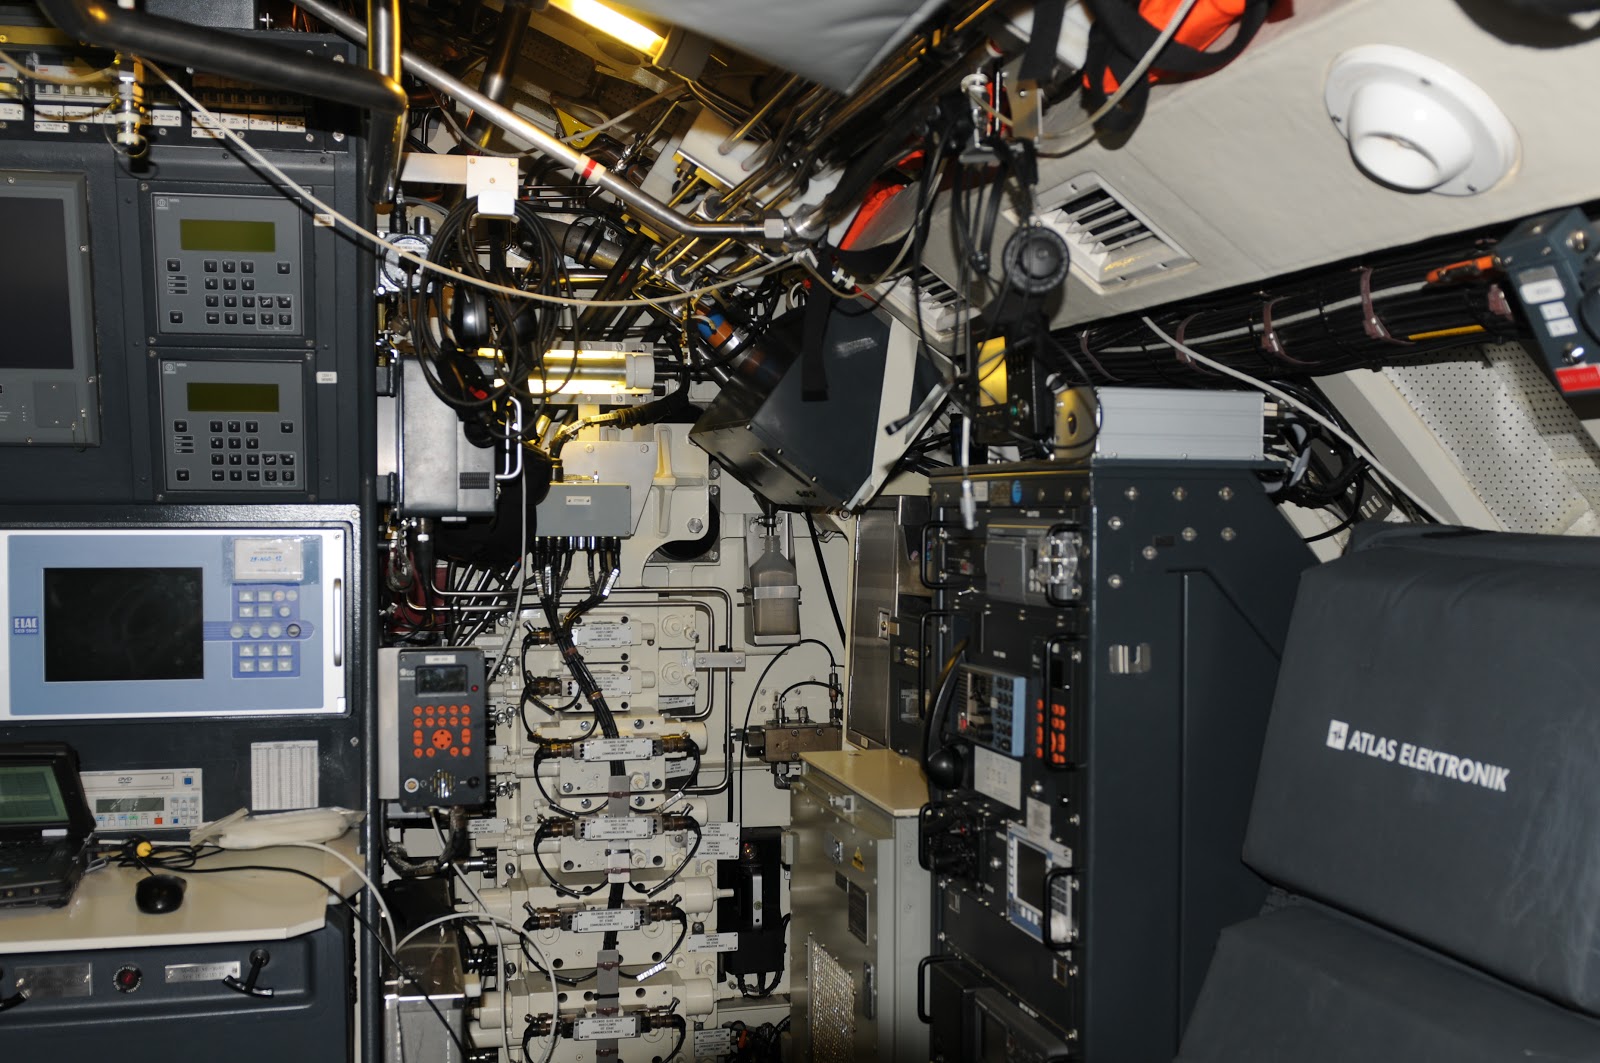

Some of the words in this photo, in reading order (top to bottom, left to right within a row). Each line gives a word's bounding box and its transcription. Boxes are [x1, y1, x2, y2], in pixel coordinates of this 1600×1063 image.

[14, 618, 38, 628] ELAC
[1348, 730, 1398, 762] ATLAS
[1398, 743, 1510, 792] ELEKTRONIK
